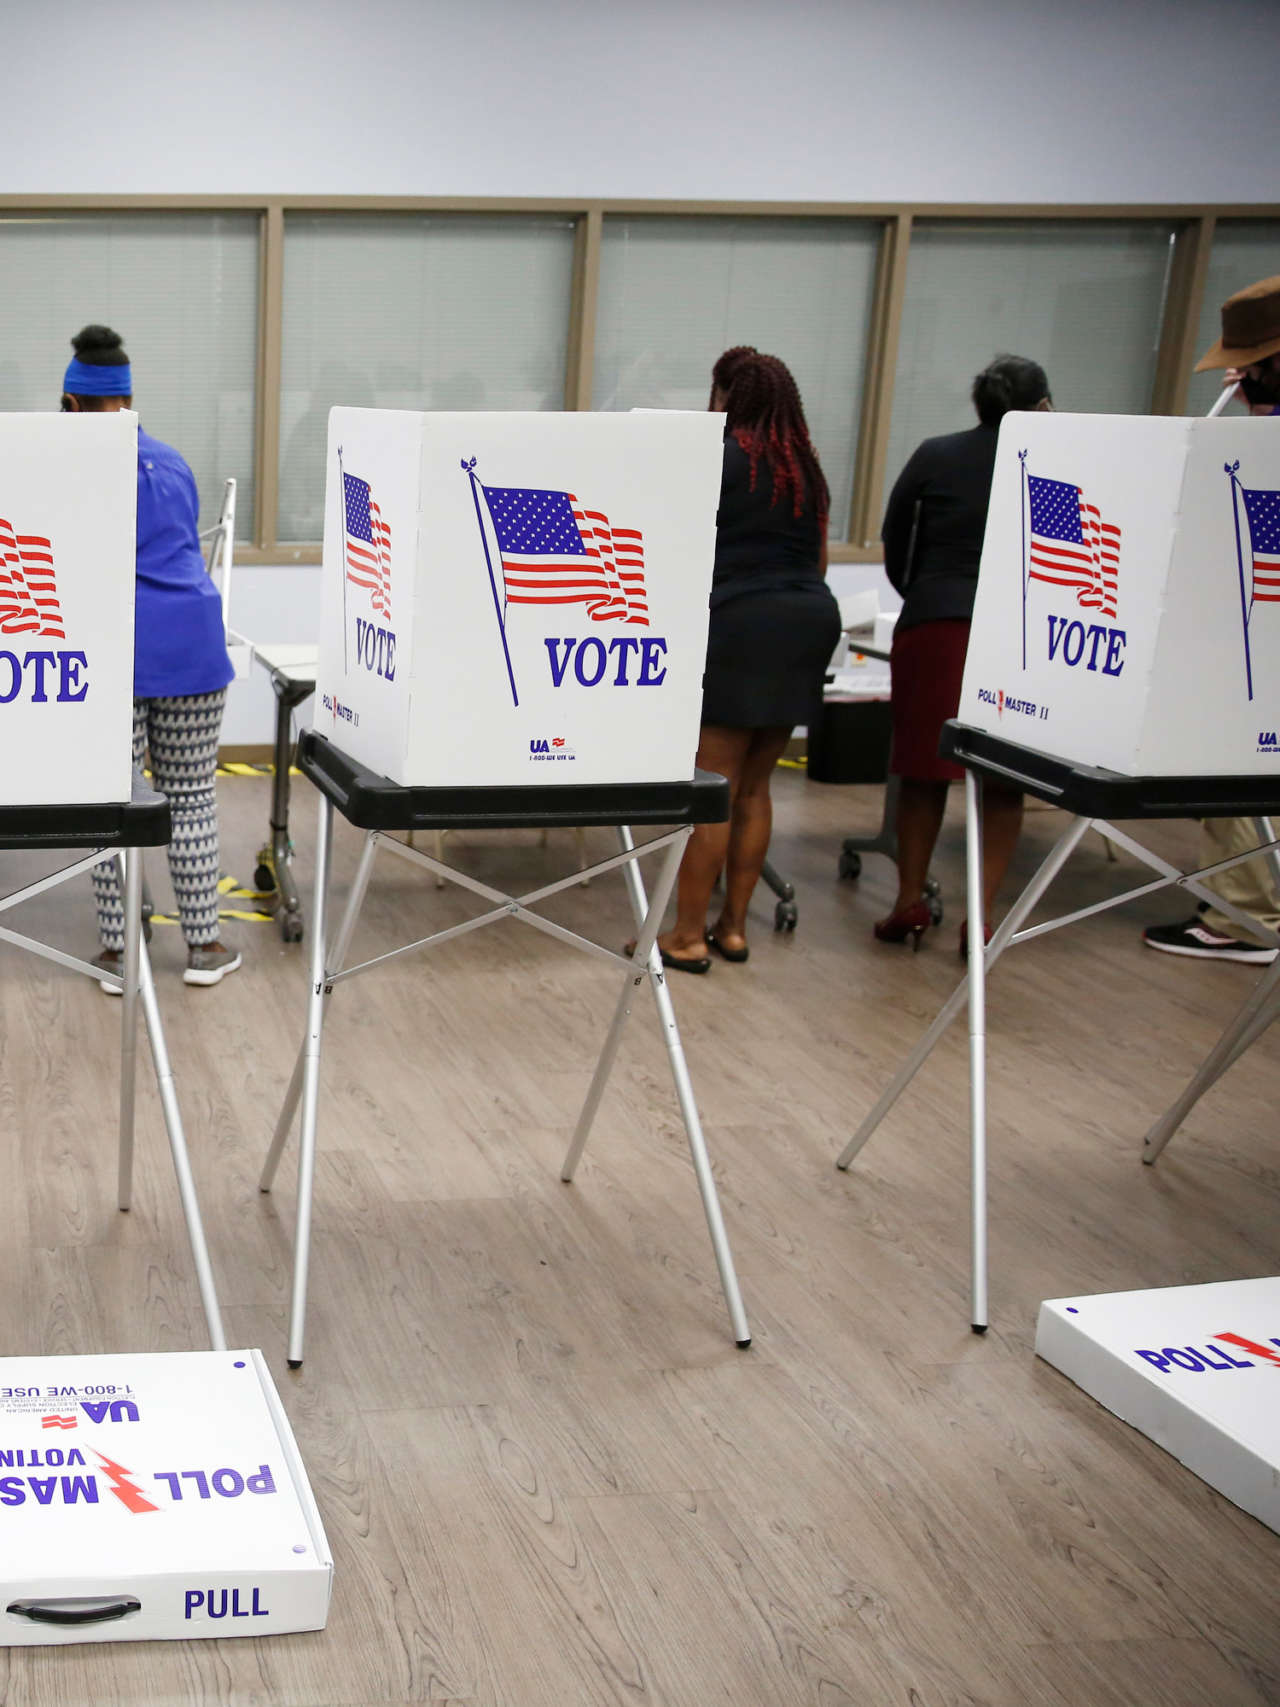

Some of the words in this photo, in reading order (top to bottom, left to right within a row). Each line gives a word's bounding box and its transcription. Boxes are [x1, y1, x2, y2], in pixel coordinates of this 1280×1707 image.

[357, 617, 397, 682] VOTE
[1047, 615, 1127, 677] VOTE
[544, 637, 668, 688] VOTE
[322, 693, 333, 711] POLL
[336, 702, 353, 724] MASTER
[978, 688, 997, 705] POLL
[1004, 696, 1037, 717] MASTER
[530, 739, 550, 753] UA
[1258, 732, 1277, 746] UA
[1133, 1344, 1256, 1374] POLL
[1, 1387, 41, 1398] USE
[47, 1385, 133, 1397] 1-800-WE
[79, 1400, 140, 1424] UA
[153, 1464, 277, 1501] POLL
[185, 1587, 270, 1619] PULL
